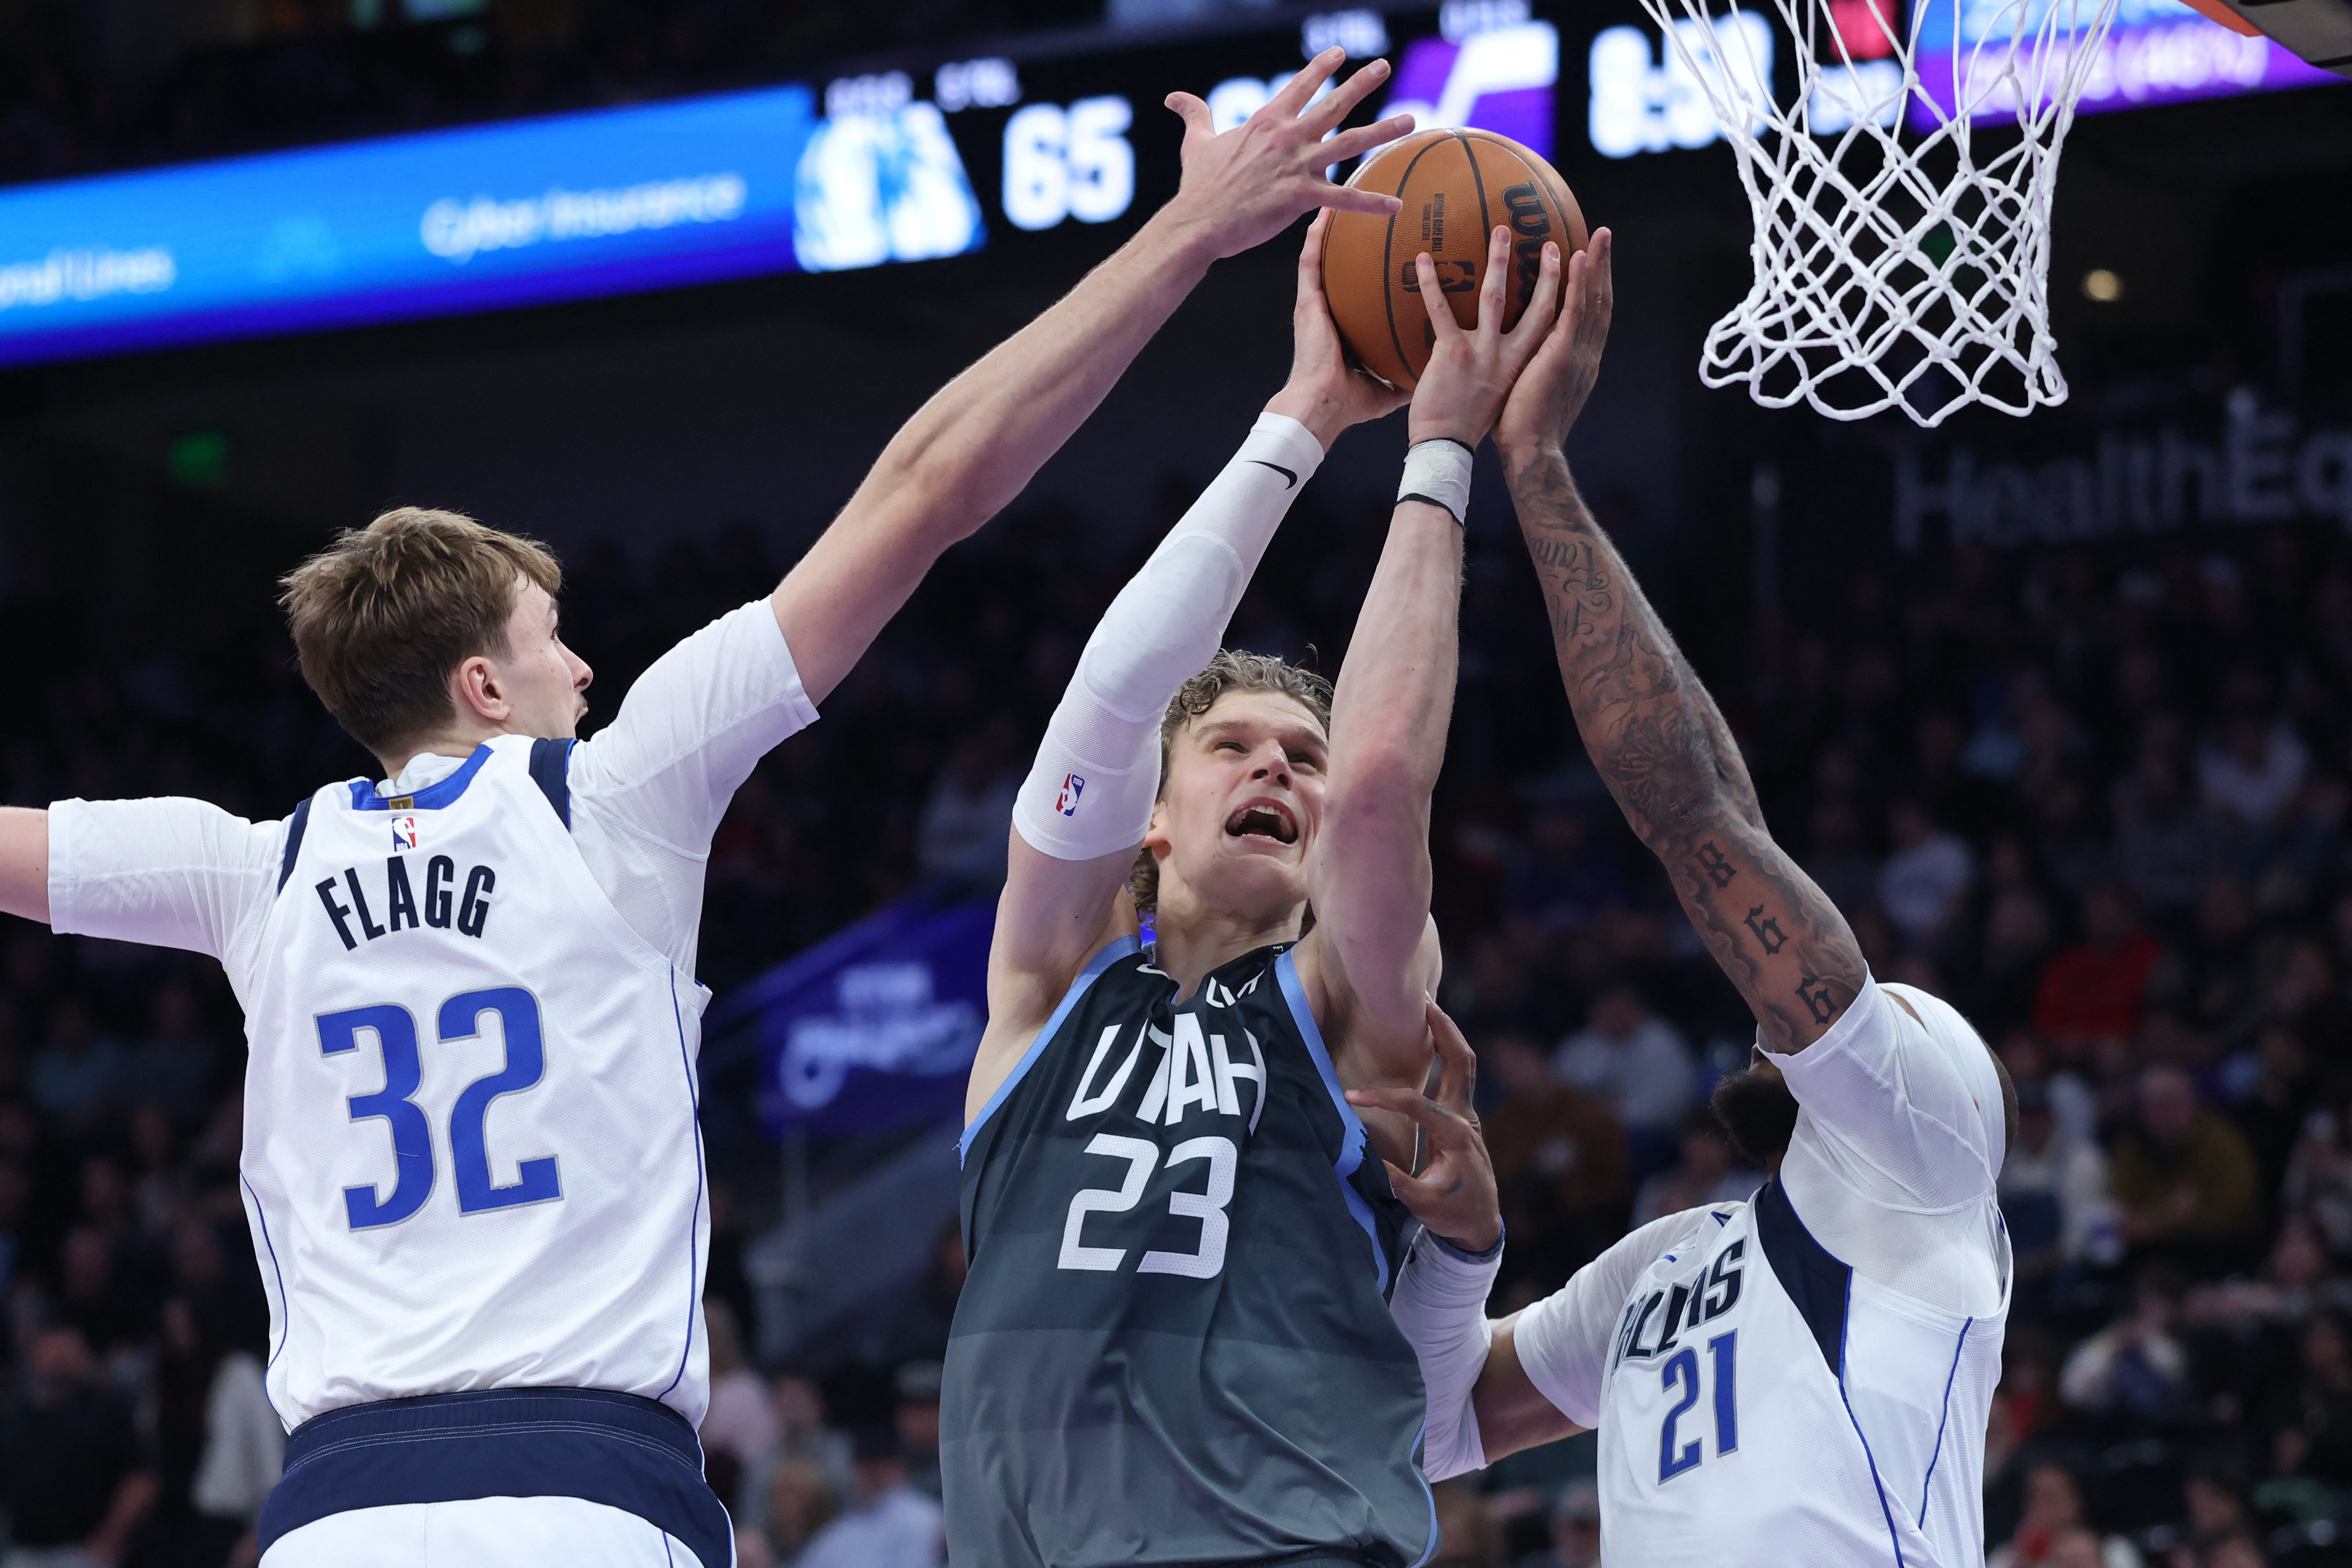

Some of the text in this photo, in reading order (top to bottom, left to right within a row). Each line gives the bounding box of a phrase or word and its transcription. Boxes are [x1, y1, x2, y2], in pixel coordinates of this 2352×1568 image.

[1002, 96, 1135, 231] 65
[1432, 219, 1444, 236] GAME
[1432, 238, 1443, 252] BALL
[315, 855, 496, 951] FLAGG
[396, 843, 408, 851] NBA
[313, 985, 564, 1232] 32
[1066, 1012, 1266, 1137] UTAH
[1057, 1133, 1237, 1279] 23
[1658, 1328, 1738, 1486] 21
